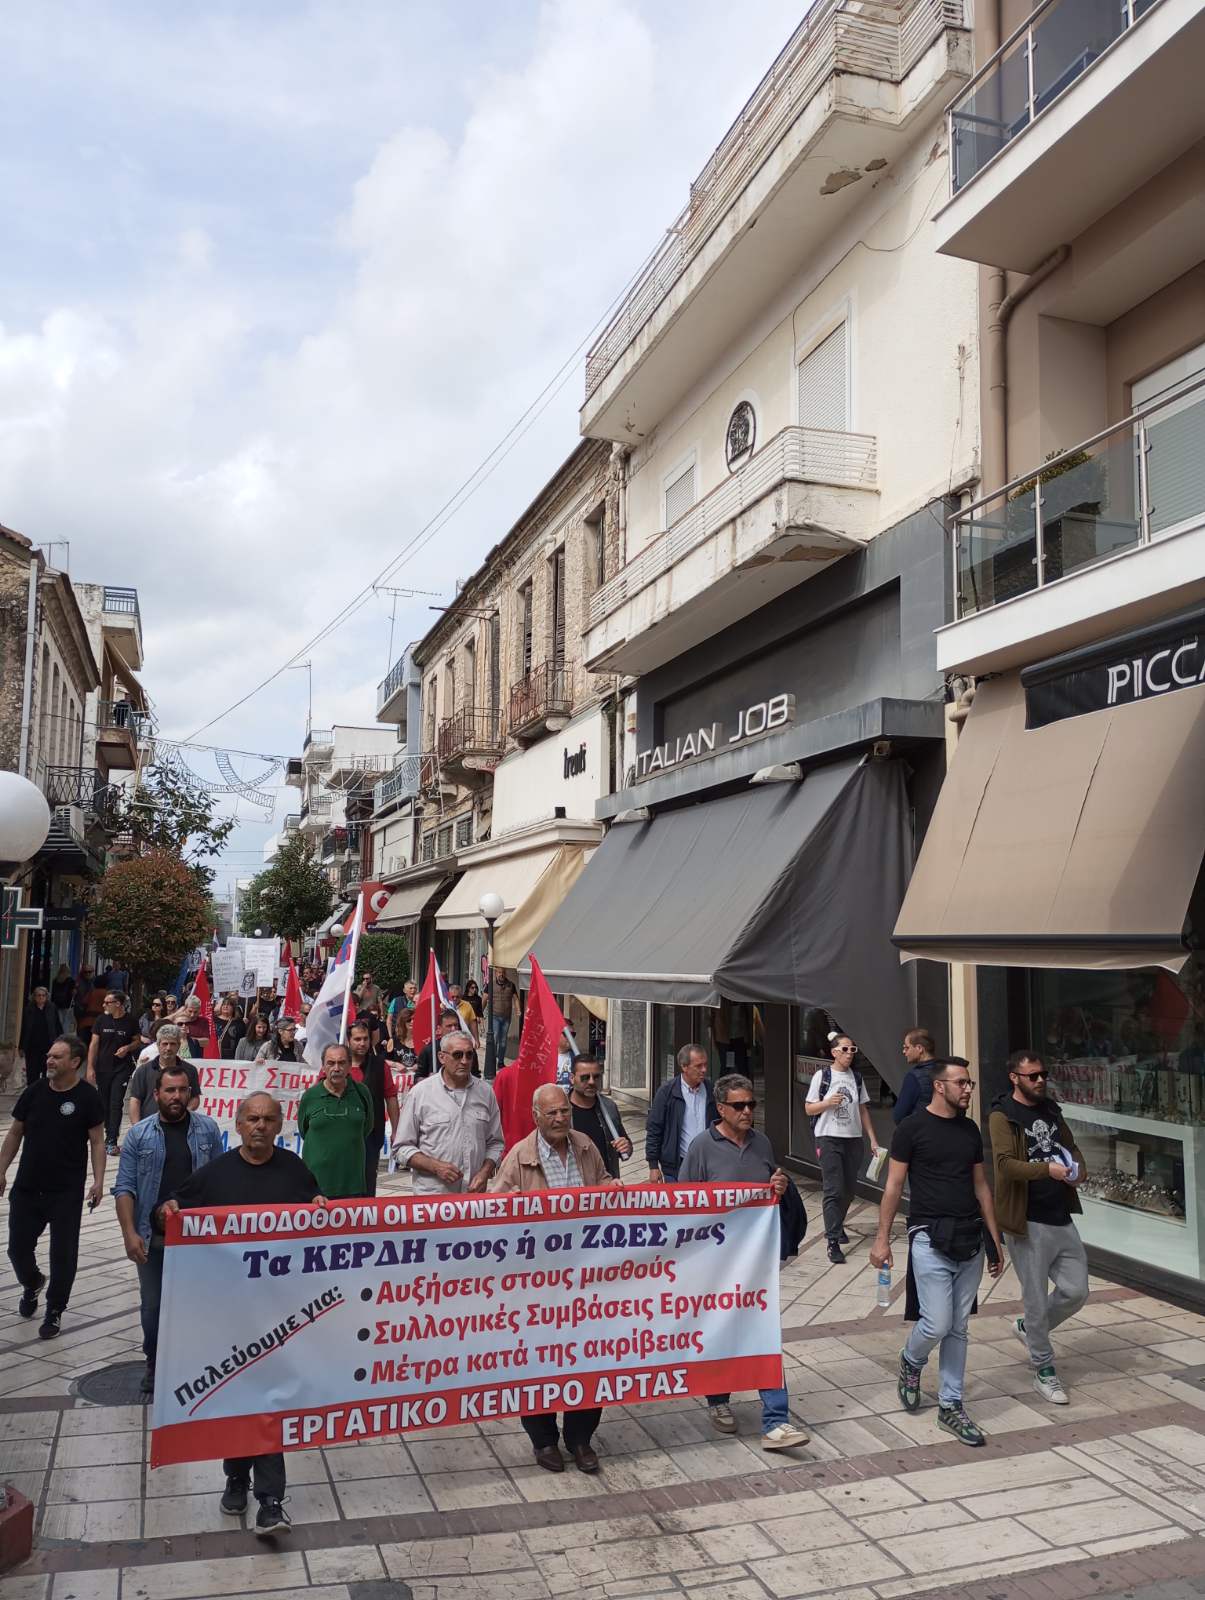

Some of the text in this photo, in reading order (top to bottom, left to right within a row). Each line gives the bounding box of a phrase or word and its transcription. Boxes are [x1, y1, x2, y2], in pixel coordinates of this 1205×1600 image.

[635, 693, 796, 778] ITALIAN JOB
[182, 1215, 217, 1236] ΝΑ
[222, 1206, 378, 1236] ΑΠΟΔΟΘΟΥΝ
[383, 1204, 407, 1225] ΟΙ
[412, 1198, 507, 1224] ΕΥΘΥΝΕΣ
[512, 1195, 544, 1216] ΓΙΑ
[548, 1193, 575, 1214] ΤΟ
[579, 1189, 670, 1212] ΕΓΚΛΗΜΑ
[674, 1188, 710, 1208] ΣΤΑ
[243, 1222, 726, 1279] Τα ΚΕΡΔΗ τους ή οι ΖΩΕΣ μας
[375, 1255, 676, 1306] Αυξήσεις στους μισθούς
[373, 1284, 768, 1345] Συλλογικές Συμβάσεις Εργασίας
[174, 1285, 344, 1407] Παλεύουμε για:
[370, 1328, 705, 1385] Μέτρα κατά της ακρίβειας
[281, 1369, 690, 1447] ΕΡΓΑΤΙΚΟ ΚΕΝΤΡΟ ΑΡΤΑΣ
